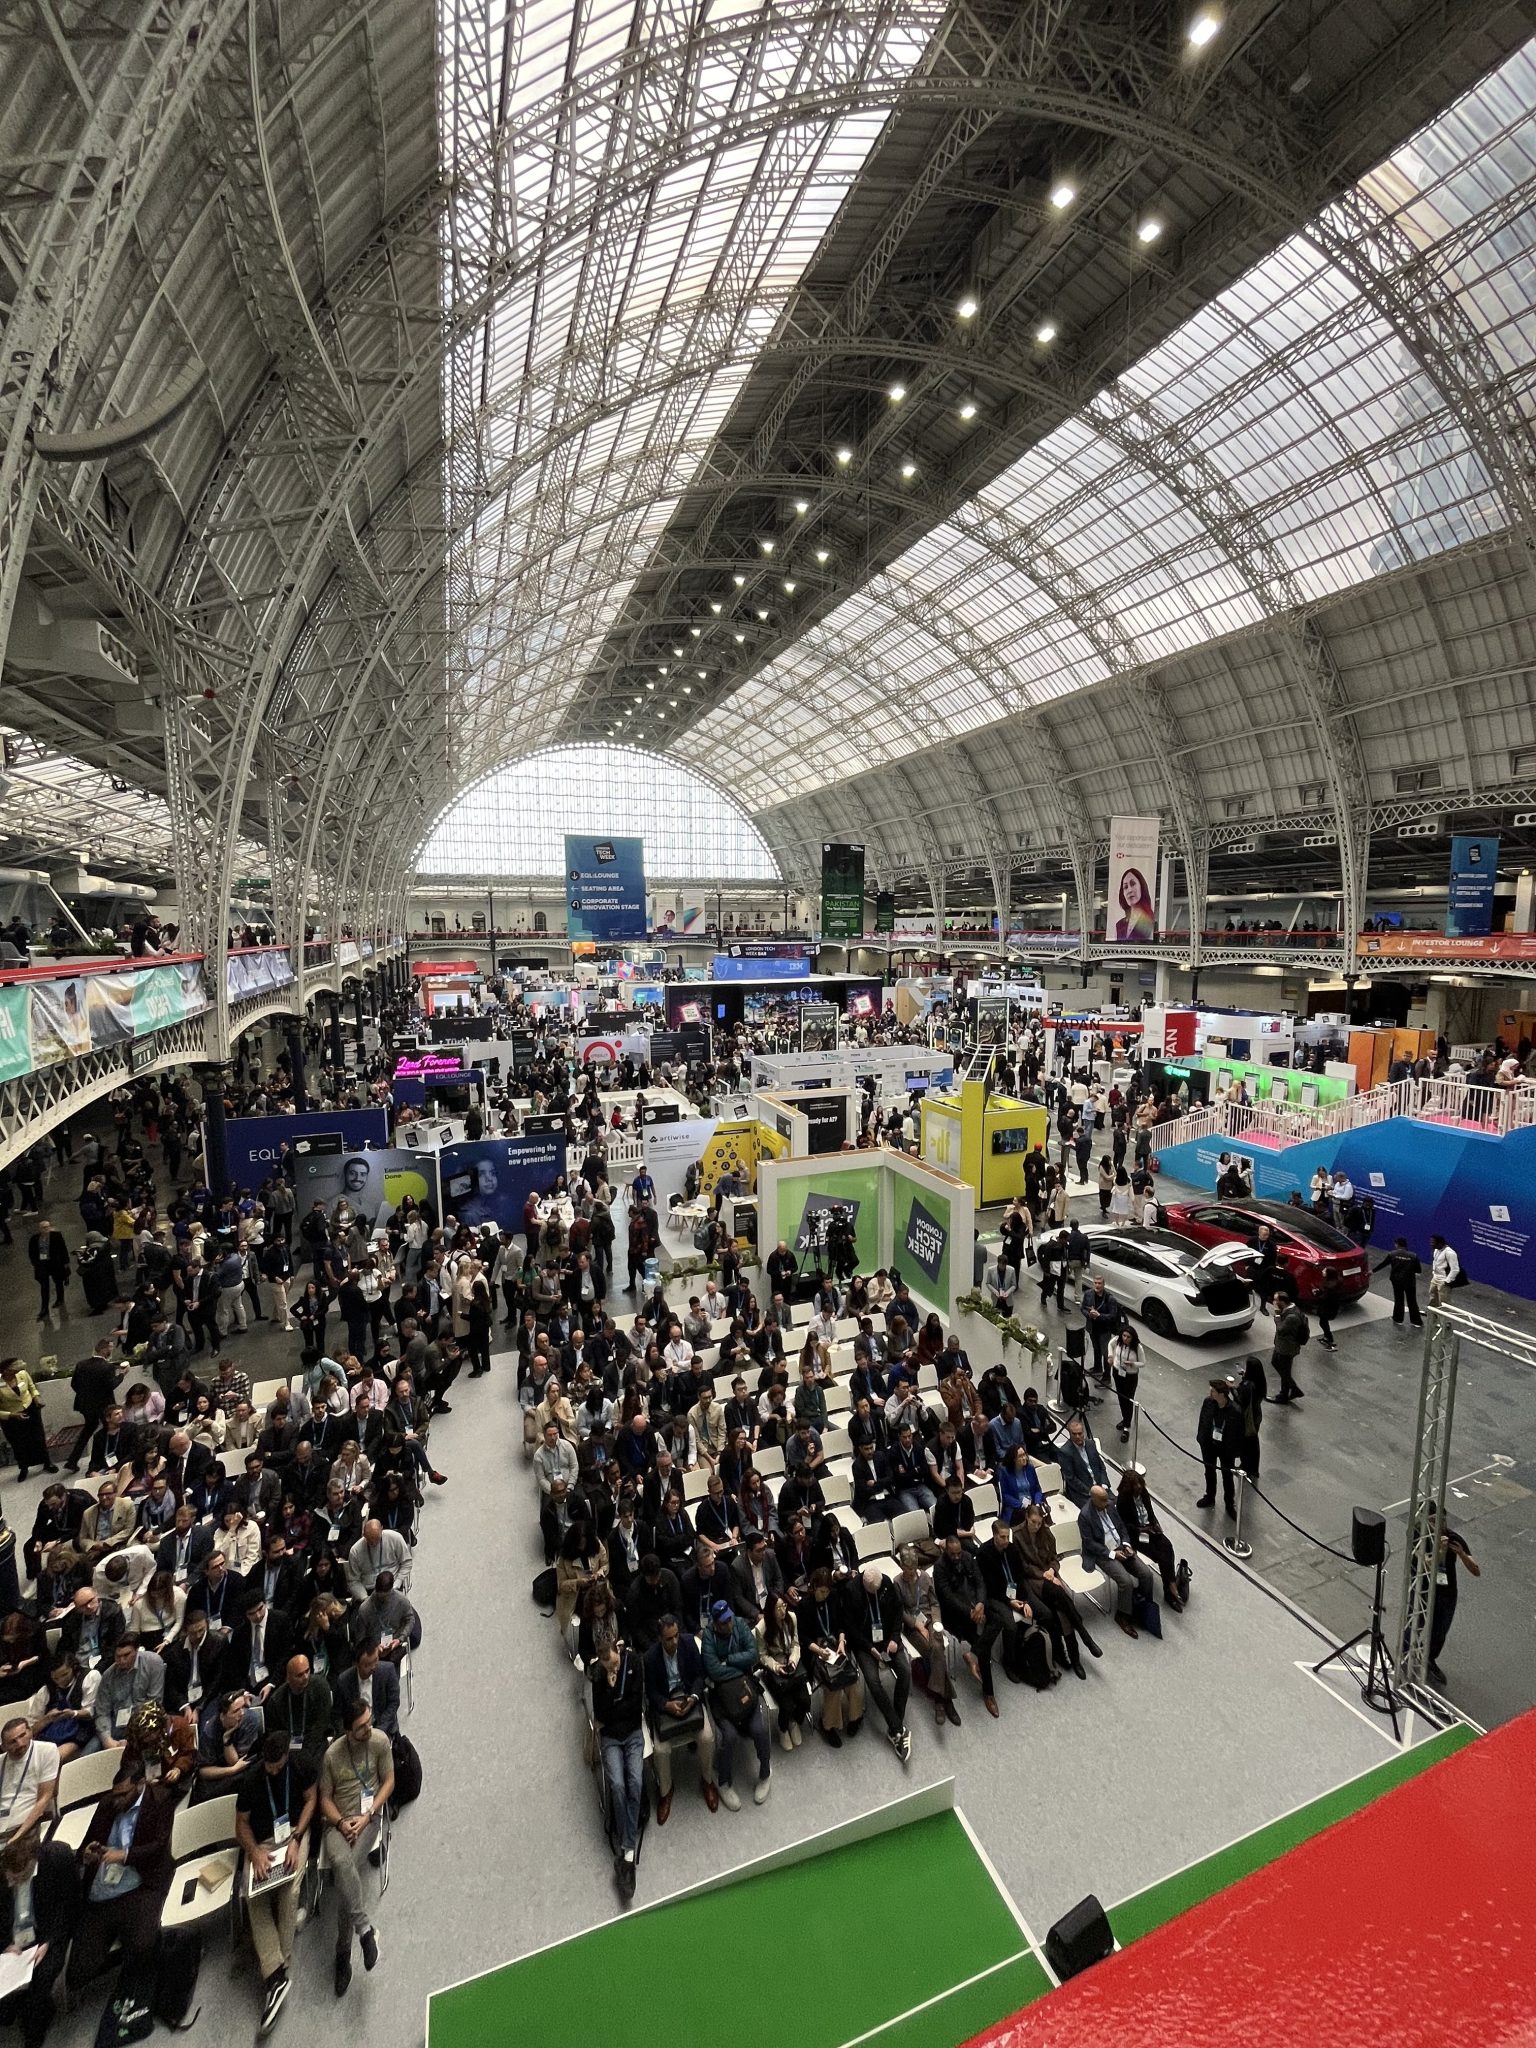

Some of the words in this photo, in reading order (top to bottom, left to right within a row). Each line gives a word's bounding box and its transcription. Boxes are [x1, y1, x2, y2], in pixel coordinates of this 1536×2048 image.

[788, 962, 804, 971] IBM
[1053, 1018, 1101, 1031] JAPAN
[659, 1134, 690, 1142] artiwise
[508, 1145, 546, 1157] Empowering
[546, 1144, 557, 1152] the
[508, 1158, 522, 1166] new
[522, 1154, 556, 1165] generation
